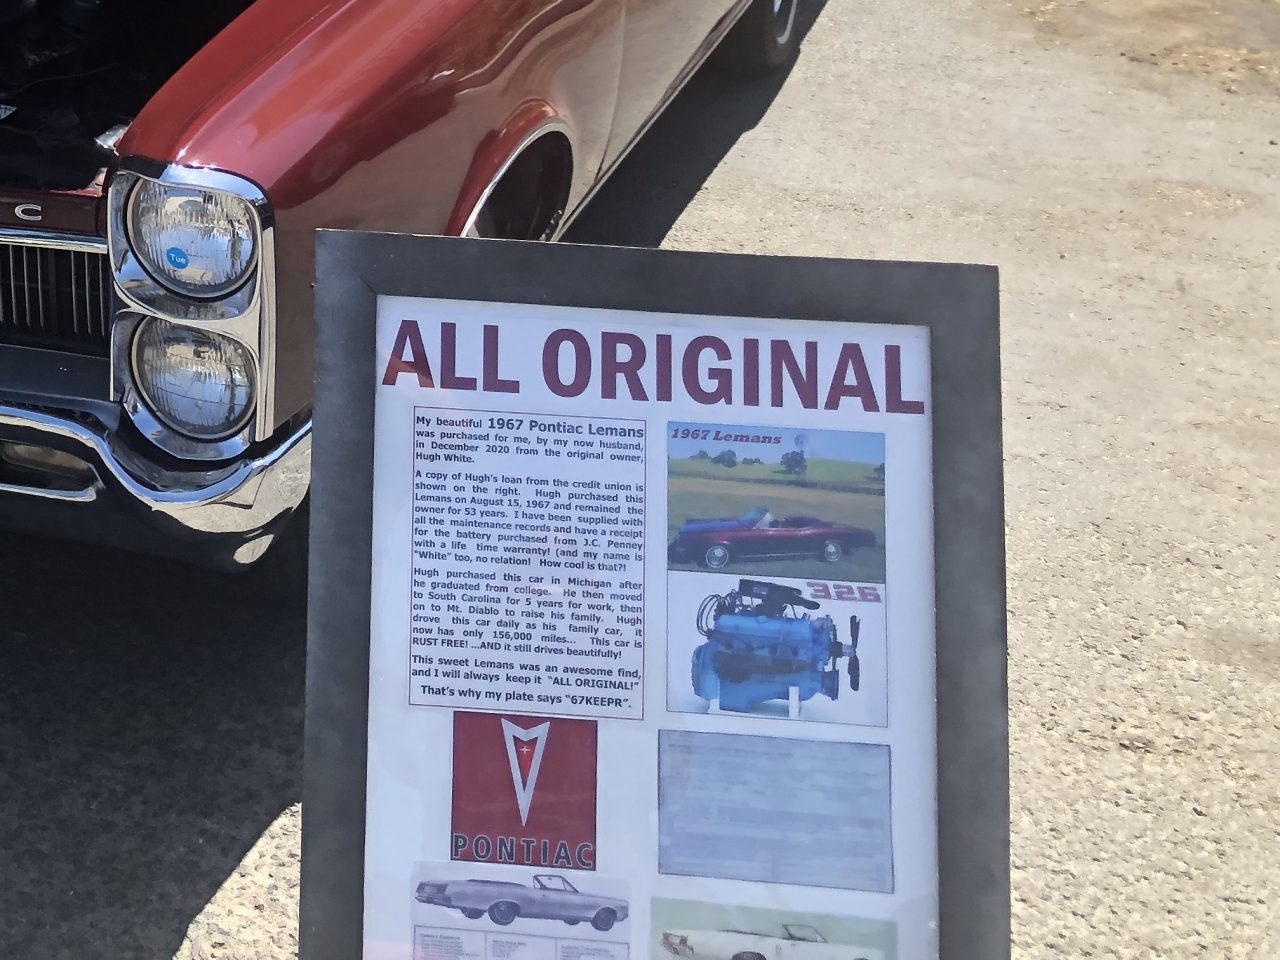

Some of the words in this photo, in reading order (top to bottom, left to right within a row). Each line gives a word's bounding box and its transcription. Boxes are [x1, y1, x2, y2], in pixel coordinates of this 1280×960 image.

[169, 254, 186, 264] Tue
[382, 319, 520, 393] ALL
[542, 328, 925, 415] ORIGINAL
[416, 415, 430, 426] My
[436, 416, 481, 428] beautiful
[488, 417, 523, 430] 1967
[529, 419, 582, 434] Pontiac
[588, 423, 643, 438] Lemans
[671, 428, 711, 440] 1967
[713, 430, 782, 445] Lemans
[416, 439, 424, 448] in
[431, 440, 478, 451] December
[485, 444, 509, 453] 2020
[515, 446, 538, 455] from
[544, 448, 560, 456] the
[566, 449, 603, 461] original
[610, 453, 642, 463] owner,
[440, 430, 489, 442] purchased
[494, 433, 508, 442] for
[513, 436, 530, 444] me,
[536, 435, 547, 446] by
[553, 438, 568, 447] my
[599, 439, 642, 451] husband,
[415, 451, 440, 462] Hugh
[443, 453, 474, 463] White.
[415, 469, 421, 477] A
[425, 471, 447, 481] copy
[451, 472, 461, 480] of
[465, 472, 497, 484] Hugh's
[501, 474, 521, 483] loan
[526, 476, 548, 485] from
[552, 478, 568, 487] the
[572, 479, 600, 489] credit
[604, 481, 631, 491] union
[635, 483, 643, 491] is
[415, 481, 445, 490] shown
[472, 484, 487, 493] the
[495, 485, 520, 497] right.
[535, 488, 560, 499] Hugh
[568, 490, 617, 503] purchased
[625, 494, 643, 503] this
[415, 492, 451, 502] Lemans
[470, 496, 503, 507] August
[507, 498, 521, 508] 15,
[526, 499, 549, 508] 1967
[553, 501, 571, 510] and
[575, 502, 620, 513] remained
[627, 505, 642, 515] the
[414, 505, 444, 514] owner
[447, 505, 461, 514] for
[464, 507, 476, 515] 53
[479, 509, 507, 519] years.
[514, 510, 518, 518] I
[522, 510, 544, 520] have
[548, 512, 571, 521] been
[577, 514, 618, 526] supplied
[621, 517, 642, 526] with
[414, 515, 425, 524] all
[429, 516, 444, 525] the
[450, 517, 511, 529] maintenance
[515, 522, 550, 532] records
[553, 524, 571, 533] and
[574, 525, 597, 535] have
[609, 528, 642, 539] receipt
[414, 527, 428, 535] for
[434, 528, 449, 537] the
[456, 529, 491, 541] battery
[497, 532, 547, 545] purchased
[554, 535, 576, 545] from
[607, 539, 642, 551] Penney
[414, 538, 435, 547] with
[451, 540, 466, 549] life
[476, 542, 497, 551] time
[503, 544, 549, 557] warranty!
[555, 547, 577, 558] (and
[583, 551, 597, 560] my
[603, 552, 629, 560] name
[635, 552, 641, 561] is
[454, 553, 472, 563] too,
[490, 554, 530, 565] relation!
[539, 558, 561, 567] How
[564, 559, 583, 569] cool
[587, 561, 594, 570] is
[597, 562, 625, 571] that?!
[412, 566, 438, 579] Hugh
[446, 568, 495, 581] purchased
[503, 572, 521, 582] this
[551, 575, 559, 584] in
[568, 577, 611, 589] Michigan
[619, 580, 642, 589] after
[806, 581, 882, 603] 326
[412, 626, 432, 634] now
[437, 626, 454, 635] has
[462, 628, 483, 639] only
[493, 630, 531, 642] 156,000
[589, 636, 609, 646] This
[634, 639, 641, 648] is
[412, 636, 438, 646] RUST
[441, 638, 467, 648] FREE!
[504, 642, 510, 651] it
[513, 643, 531, 652] still
[533, 644, 563, 654] drives
[566, 646, 621, 660] beautifully!
[411, 654, 433, 664] This
[438, 656, 469, 666] sweet
[474, 658, 514, 669] Lemans
[519, 663, 539, 671] was
[562, 666, 612, 676] awesome
[618, 667, 640, 680] find,
[411, 666, 430, 677] and
[433, 668, 438, 677] I
[441, 668, 459, 678] will
[463, 670, 499, 683] always
[505, 672, 530, 685] keep
[534, 675, 541, 684] it
[420, 684, 454, 696] That's
[458, 687, 481, 700] why
[485, 691, 501, 701] my
[505, 690, 533, 703] plate
[537, 694, 561, 704] says
[452, 832, 594, 869] PONTIAC
